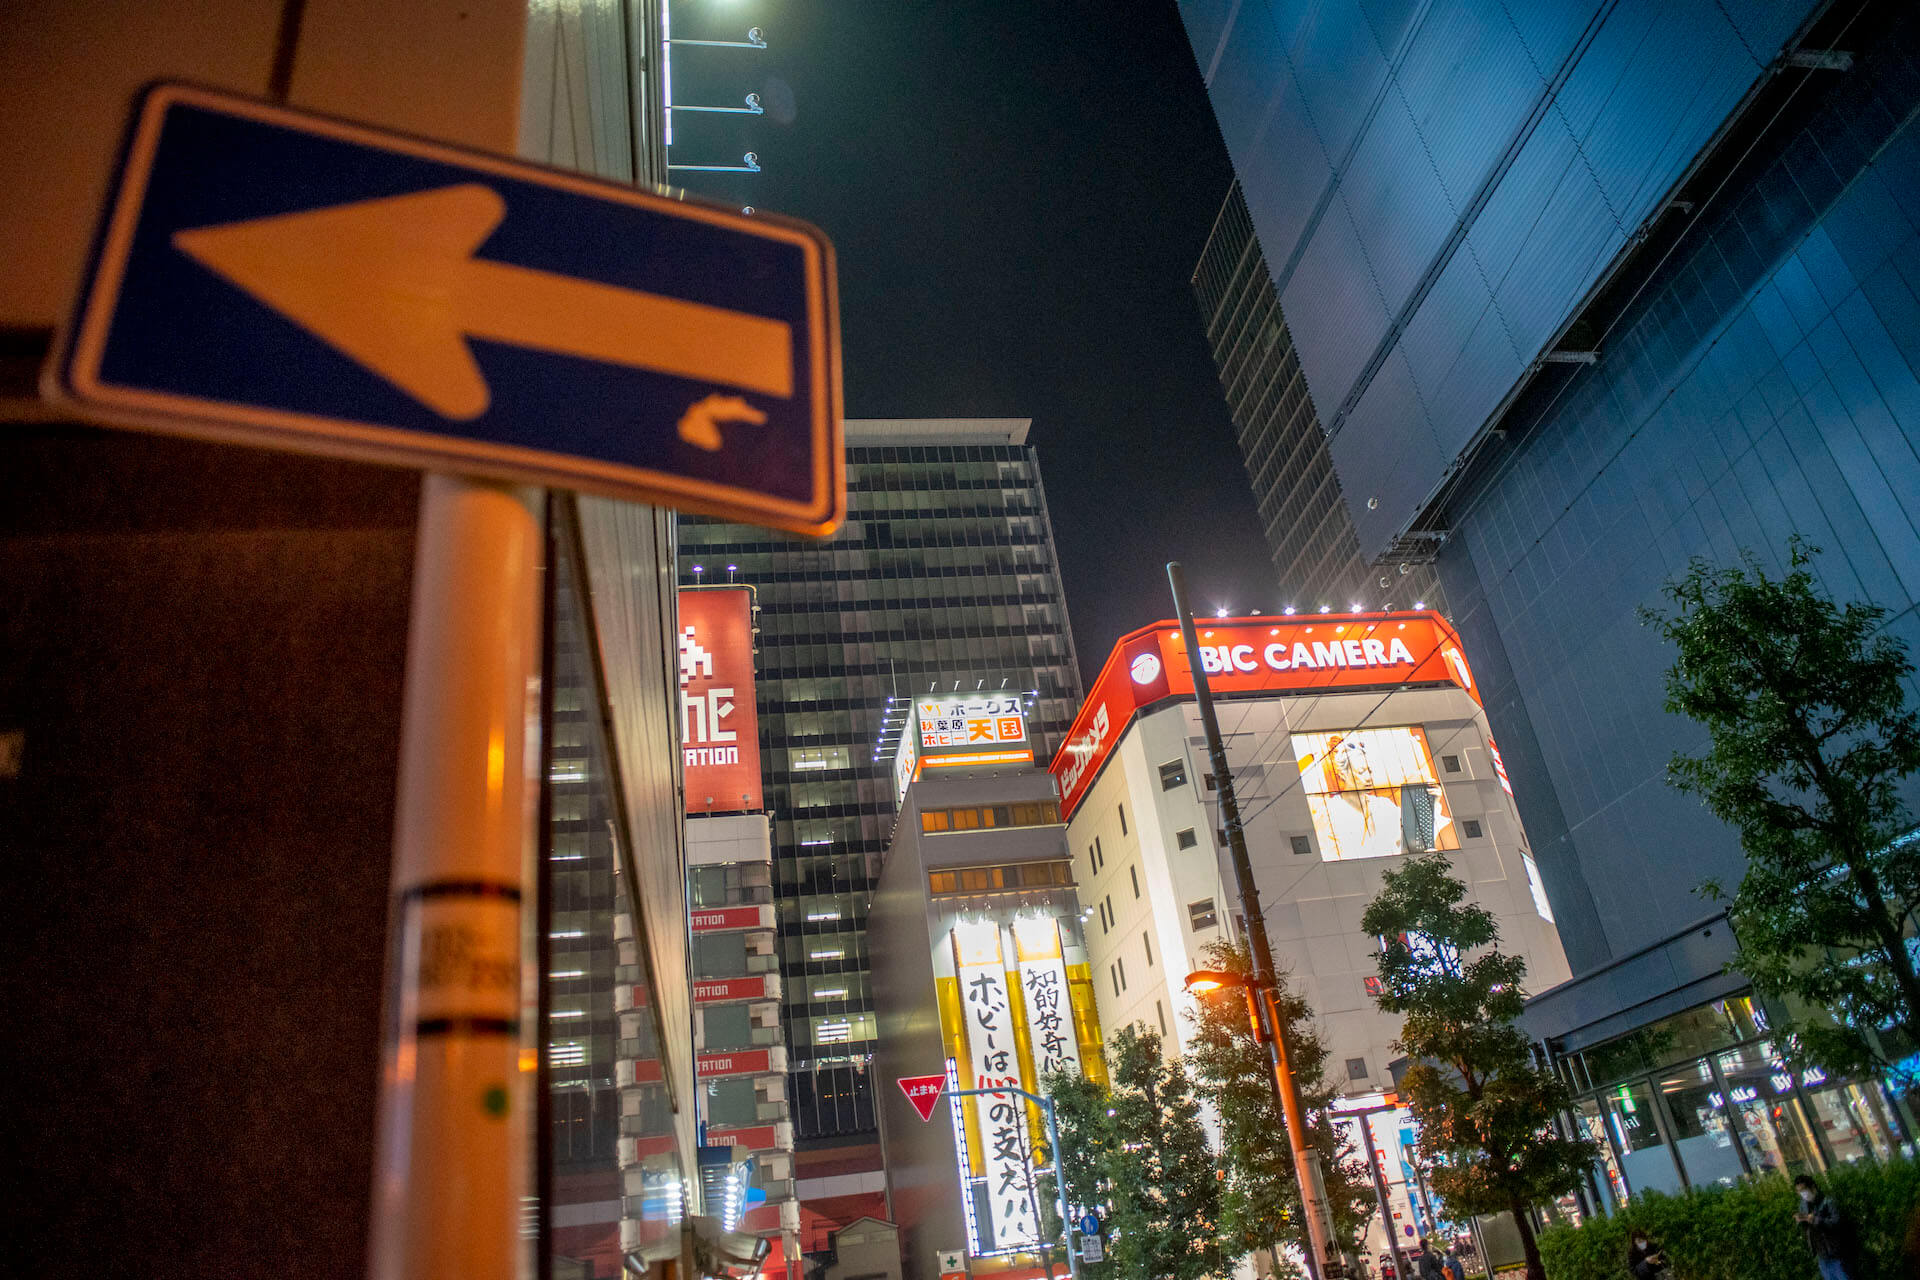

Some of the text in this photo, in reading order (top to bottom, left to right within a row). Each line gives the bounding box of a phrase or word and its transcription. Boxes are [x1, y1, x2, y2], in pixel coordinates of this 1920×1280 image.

[1199, 638, 1415, 673] BIC CAMERA
[1060, 701, 1110, 800] ビックカメラ
[910, 1084, 938, 1096] 止まれ
